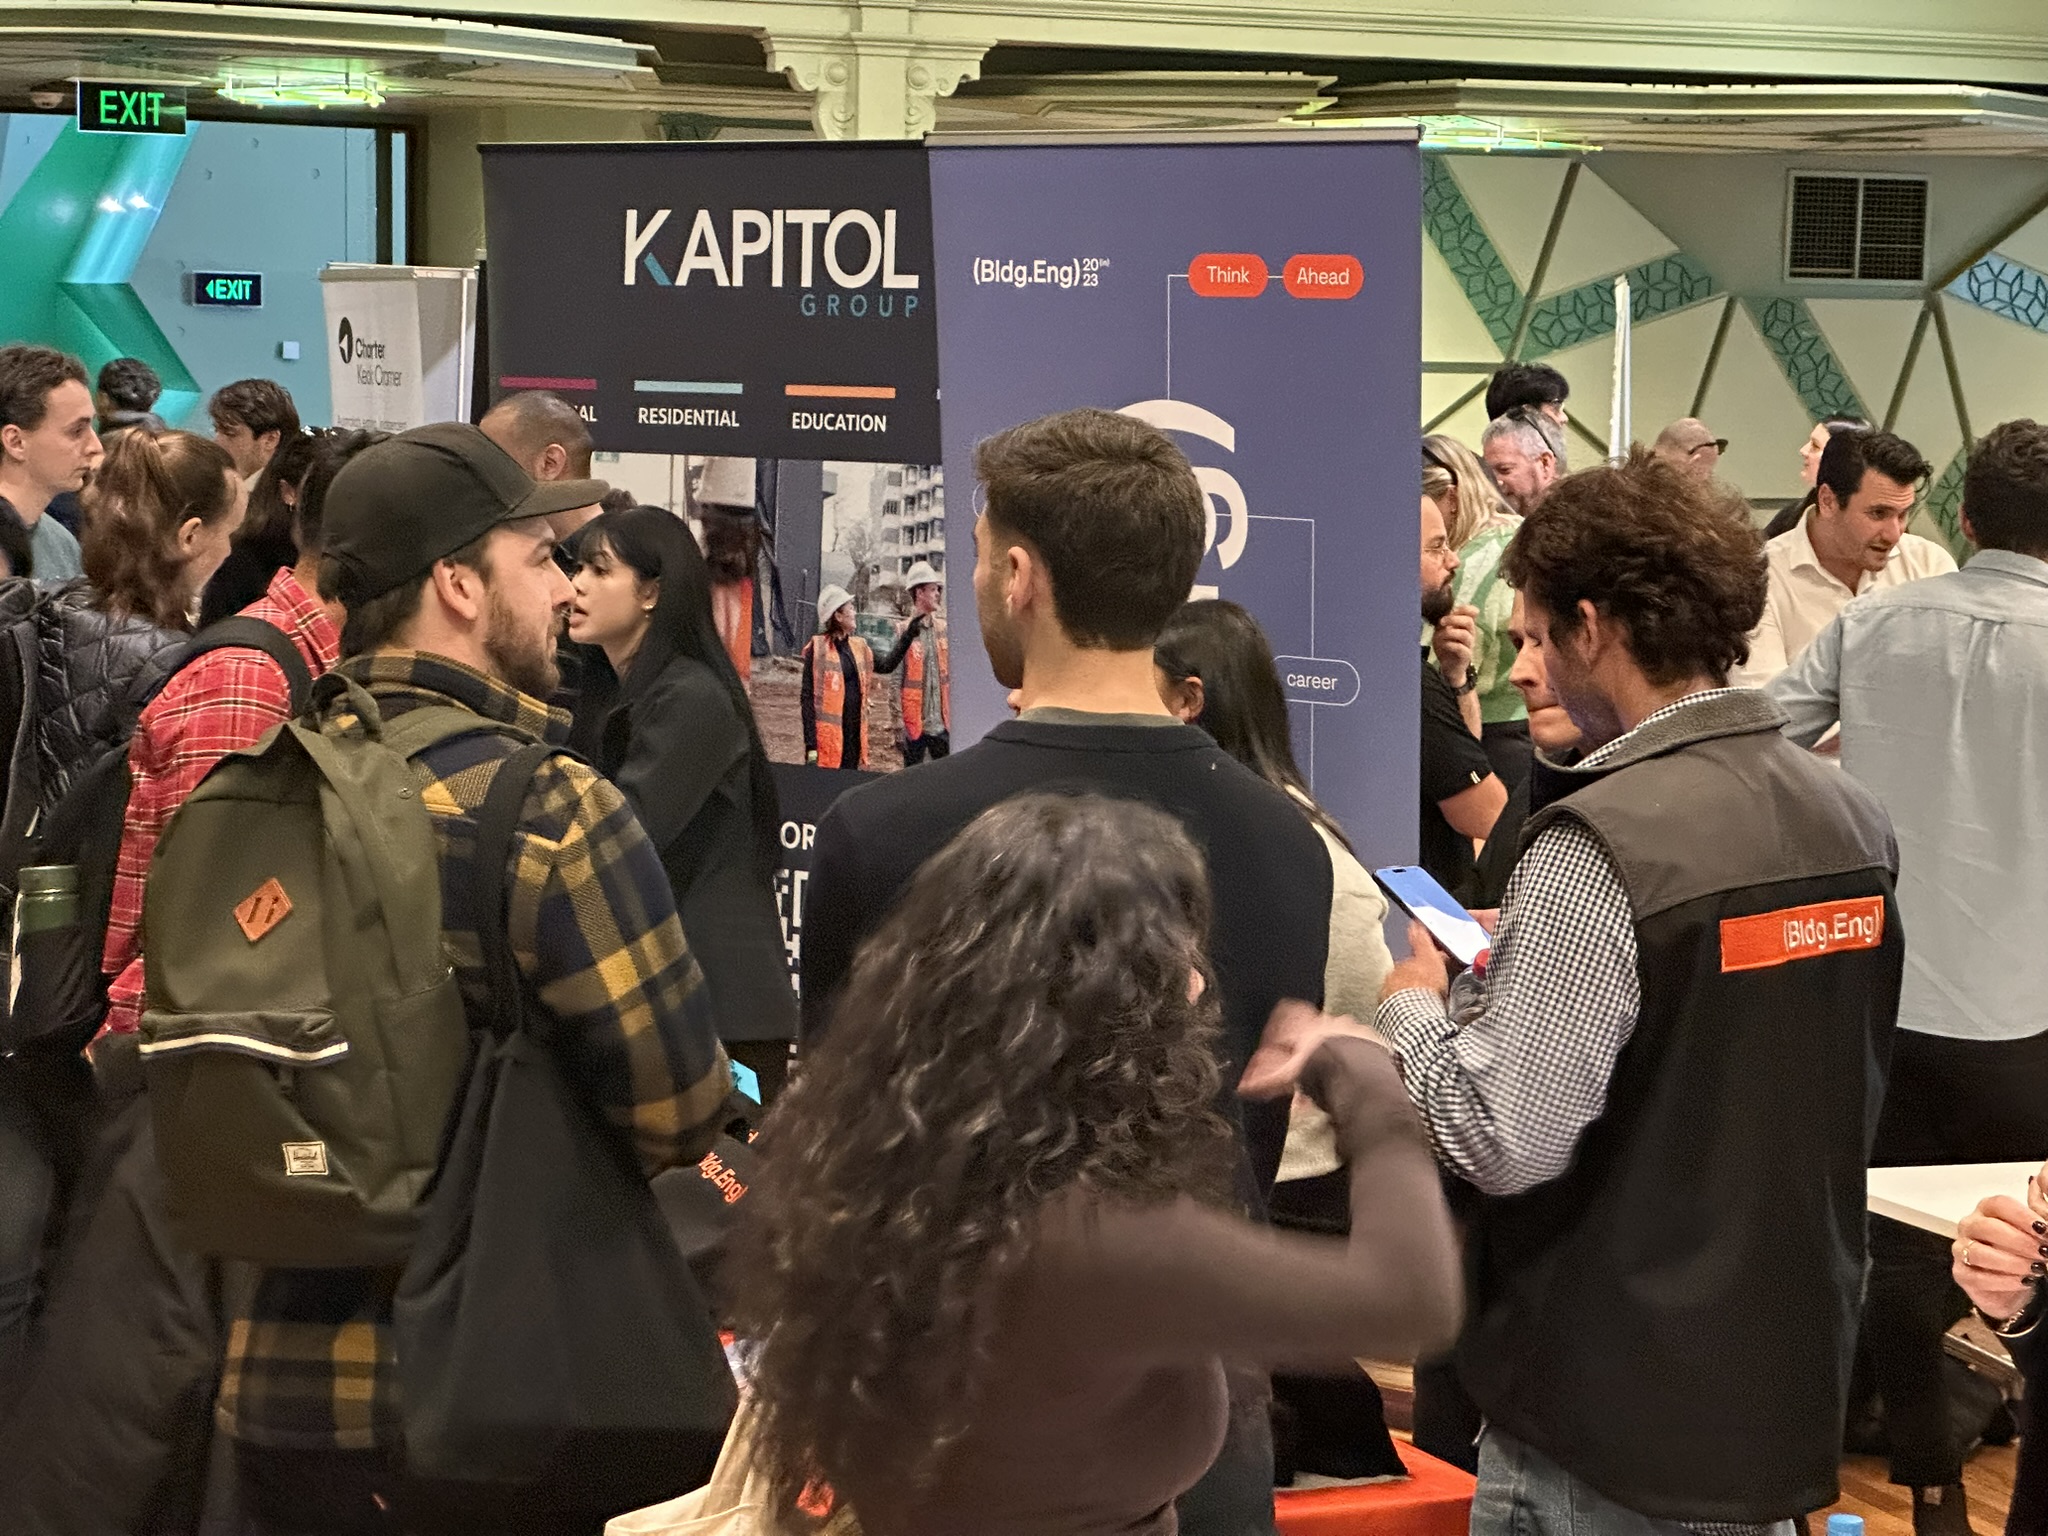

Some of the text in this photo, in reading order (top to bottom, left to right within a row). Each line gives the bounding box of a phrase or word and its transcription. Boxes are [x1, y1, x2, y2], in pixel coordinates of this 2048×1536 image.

[100, 90, 165, 126] EXIT
[624, 209, 919, 289] KAPITOL
[973, 257, 1080, 289] (Bldg.Eng)
[1082, 257, 1099, 271] 20
[1207, 265, 1250, 283] Think
[1083, 273, 1099, 287] 23
[1297, 267, 1350, 285] Ahead
[215, 279, 252, 300] EXIT
[801, 294, 919, 318] GROUP
[355, 337, 385, 359] Charter
[638, 407, 740, 428] RESIDENTIAL
[792, 412, 887, 433] EDUCATION
[1287, 673, 1338, 690] career
[1783, 906, 1881, 953] (Bldg.Eng)
